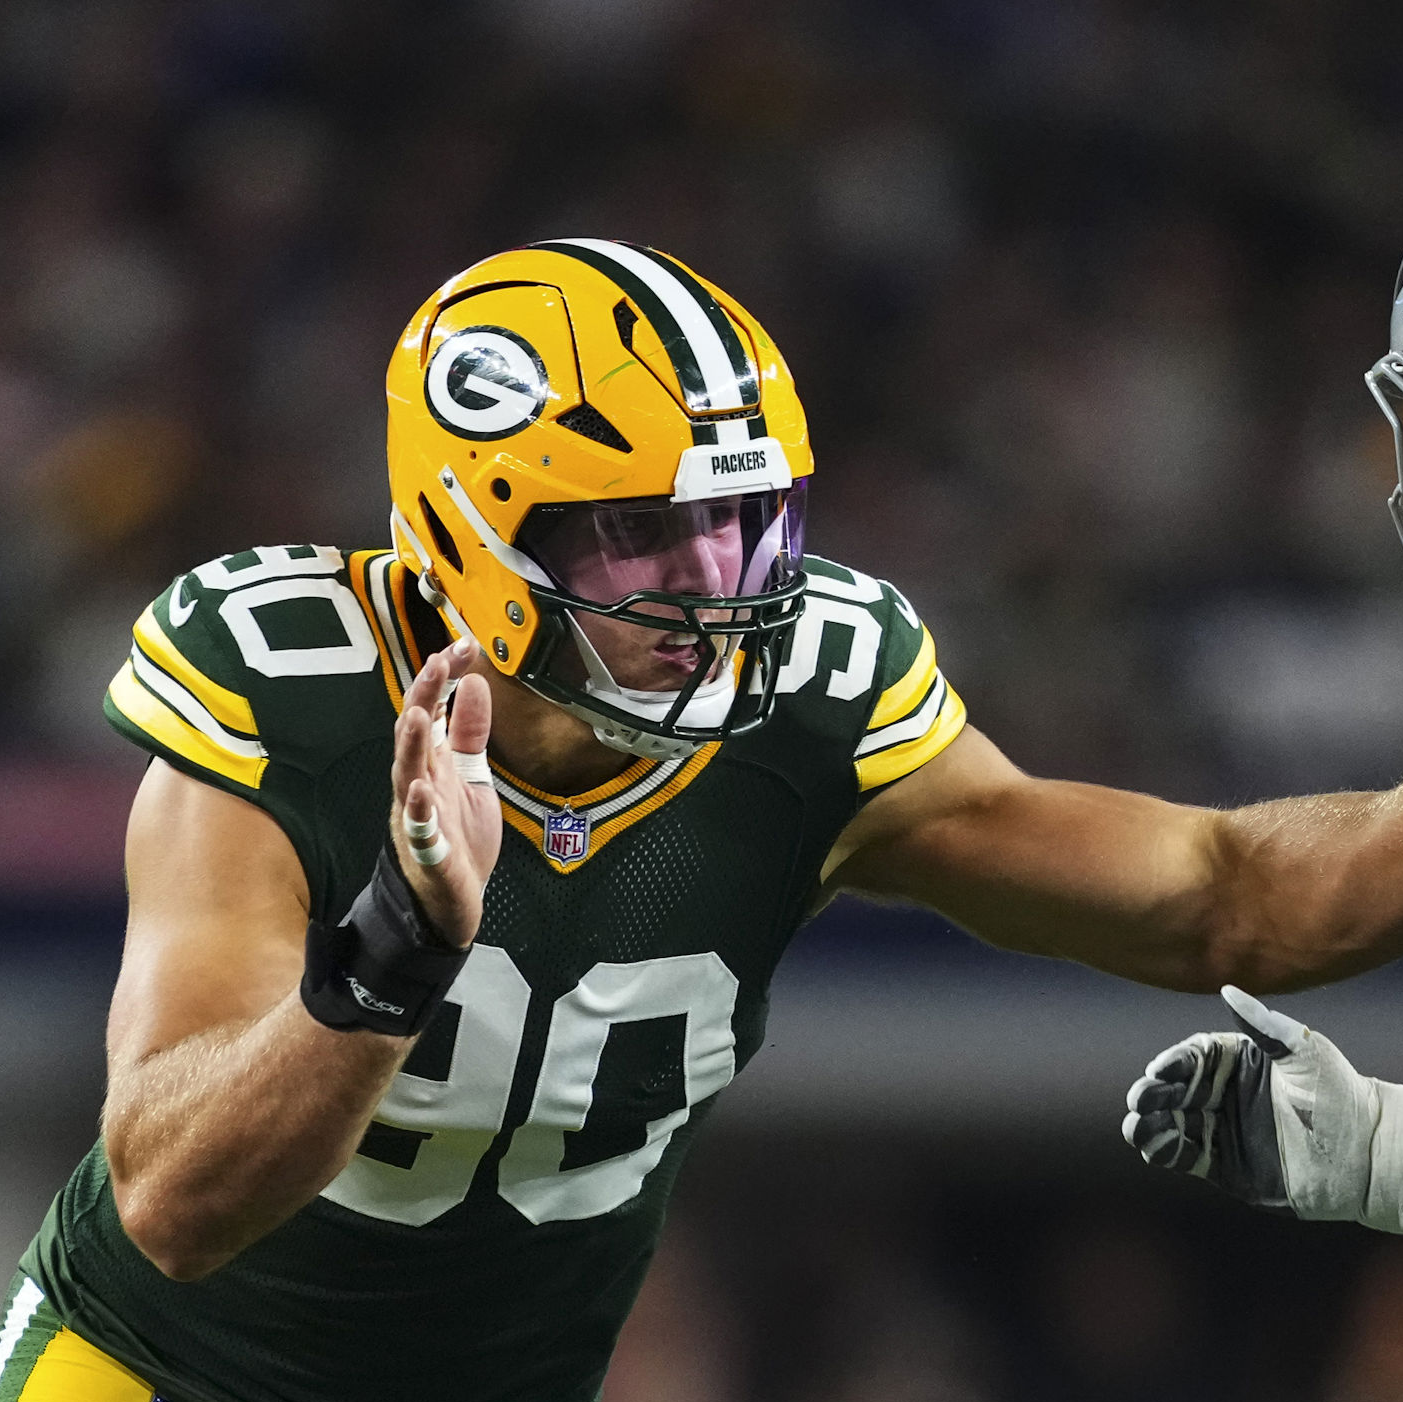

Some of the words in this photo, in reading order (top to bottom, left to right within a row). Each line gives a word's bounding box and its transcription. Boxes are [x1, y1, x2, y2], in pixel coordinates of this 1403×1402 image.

[427, 331, 540, 433] G
[711, 450, 767, 476] PACKERS
[550, 833, 581, 856] NFL
[316, 942, 740, 1227] 90
